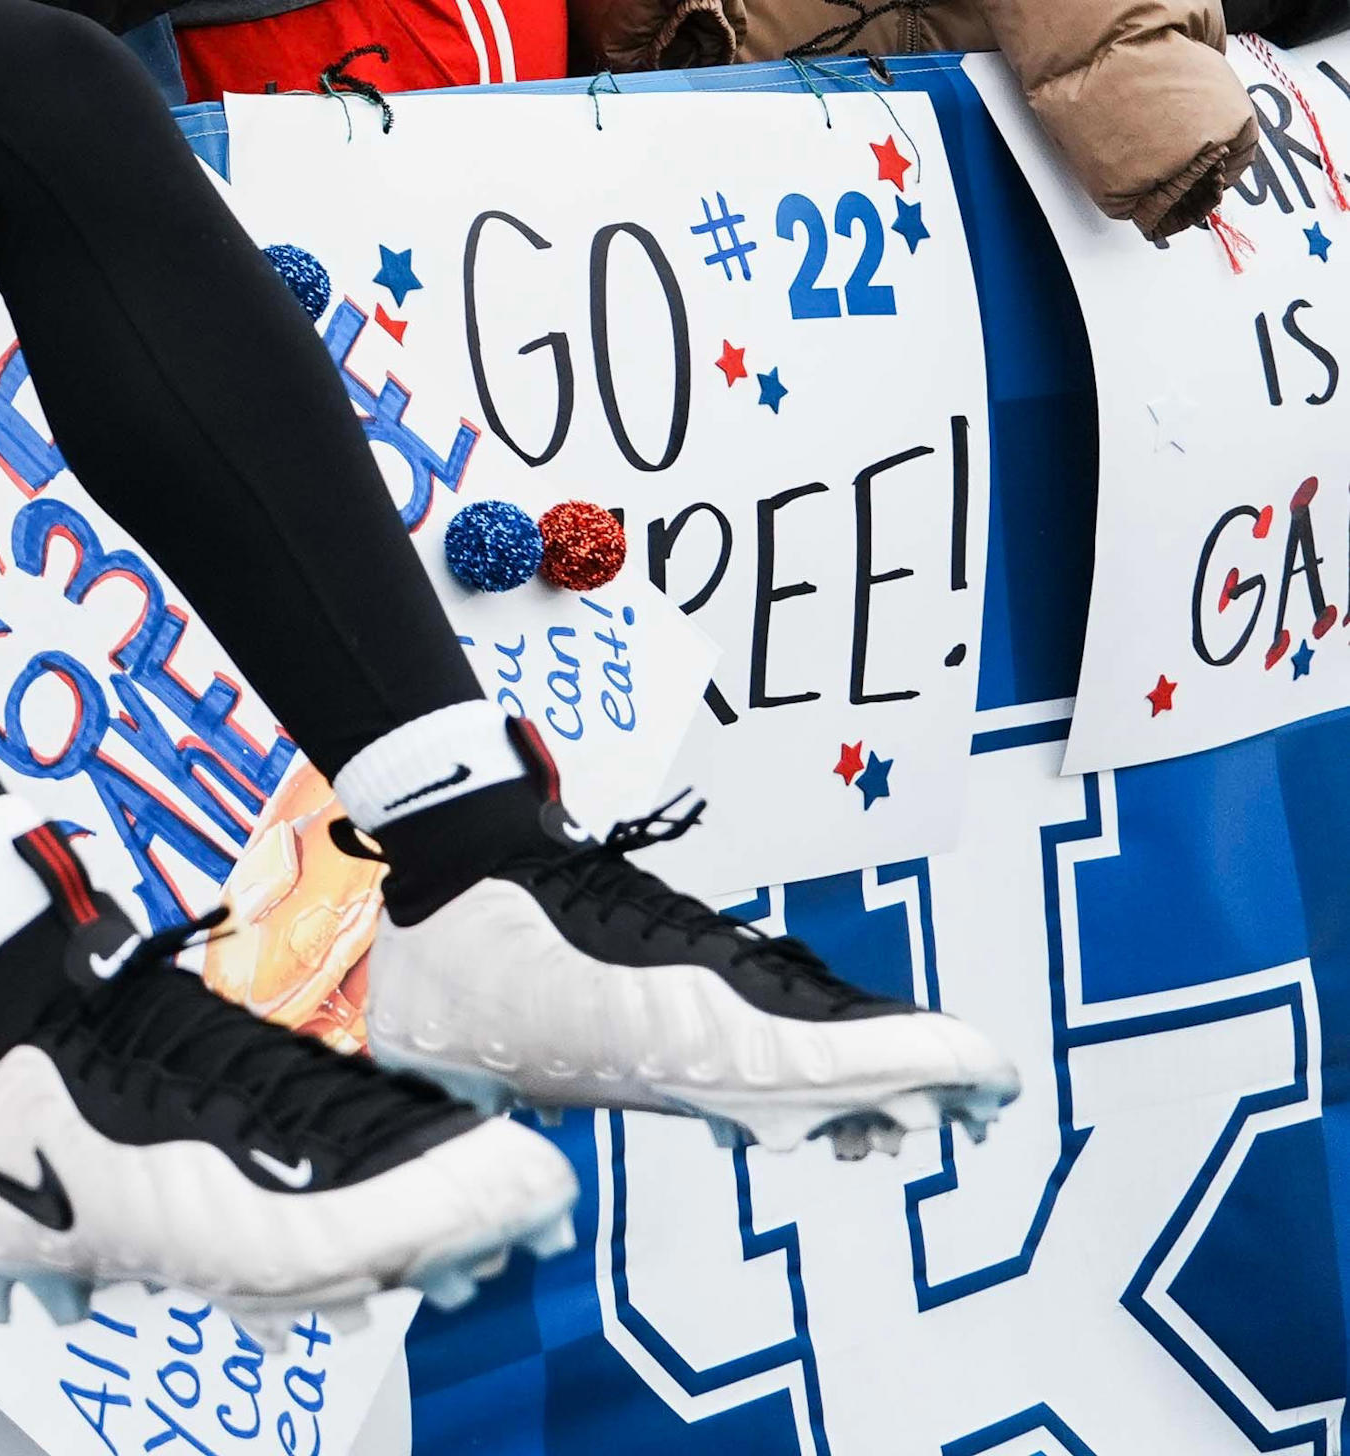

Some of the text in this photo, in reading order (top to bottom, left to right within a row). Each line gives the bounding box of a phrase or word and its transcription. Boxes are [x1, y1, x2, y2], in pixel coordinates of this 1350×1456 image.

[463, 210, 691, 471] GO
[690, 190, 898, 320] #22
[1254, 298, 1341, 407] IS
[608, 416, 970, 726] REE!
[1191, 476, 1350, 672] GA
[545, 627, 584, 741] can
[580, 597, 635, 732] eat!
